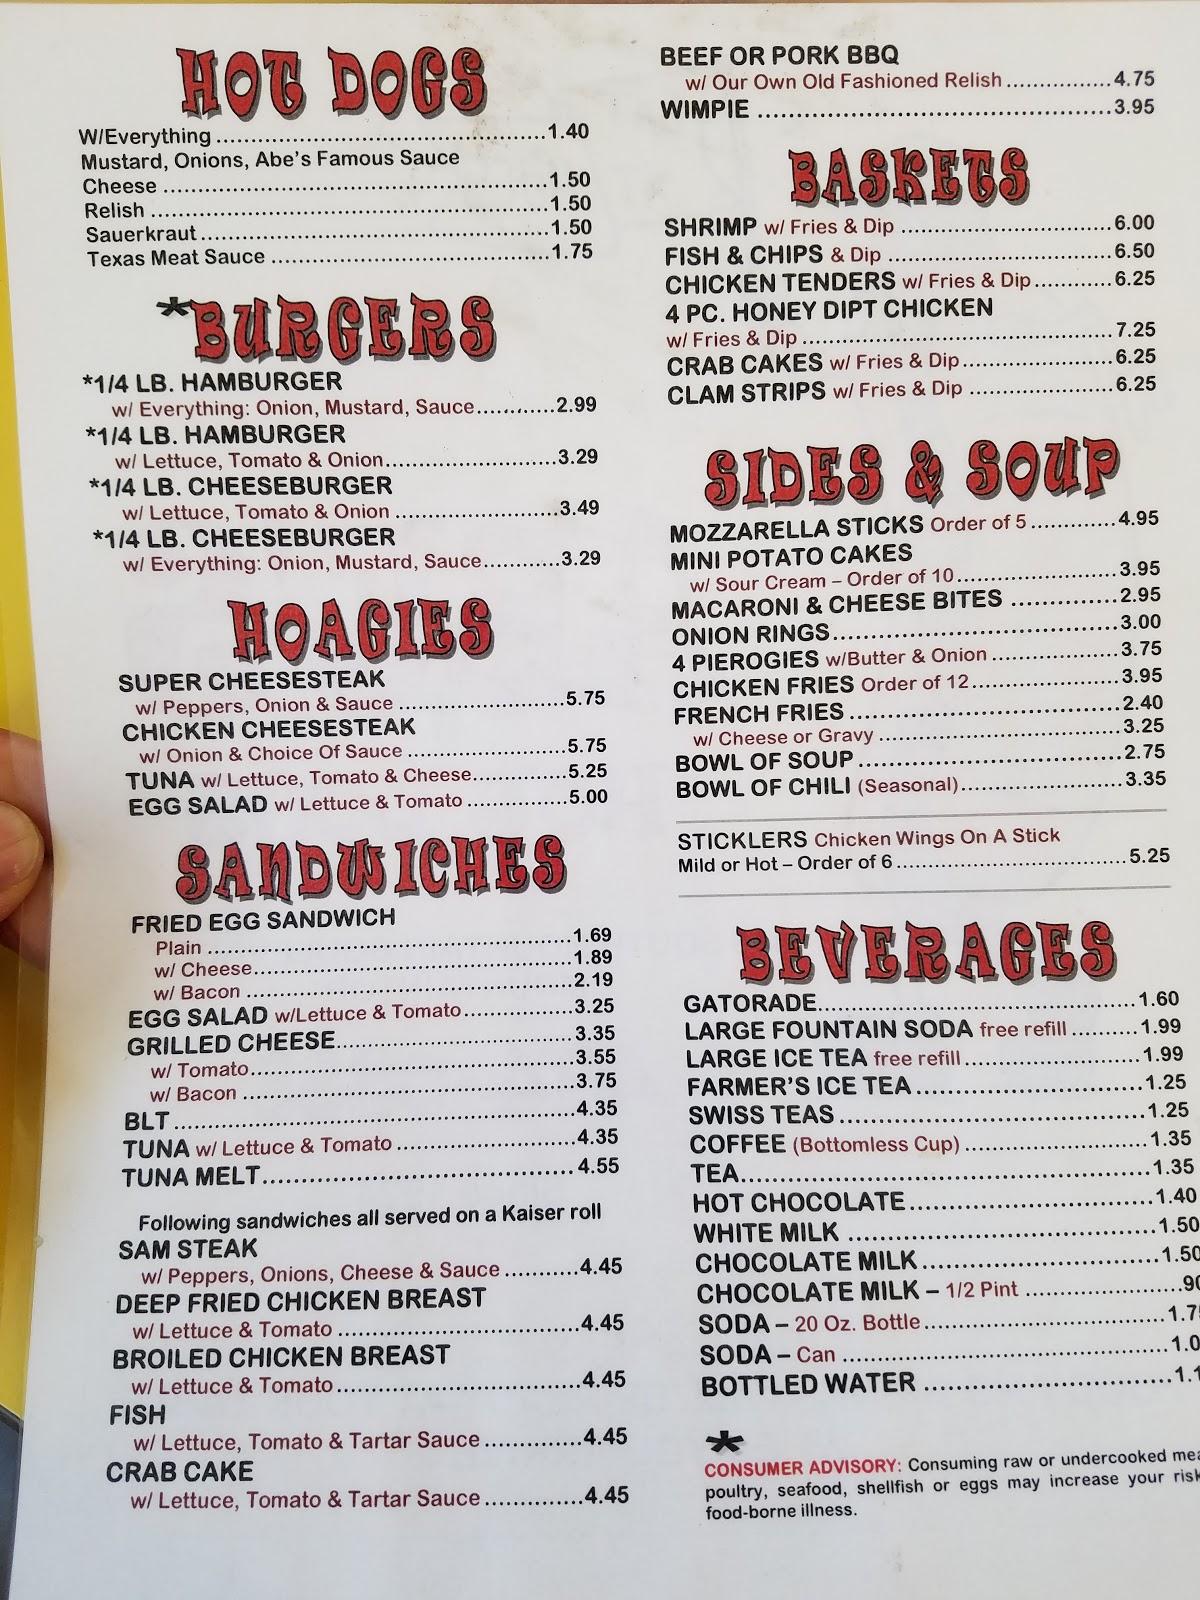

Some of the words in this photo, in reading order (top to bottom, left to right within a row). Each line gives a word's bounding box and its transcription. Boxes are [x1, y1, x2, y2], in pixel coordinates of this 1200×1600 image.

[660, 45, 724, 67] BEEF
[729, 45, 766, 67] OR
[771, 44, 840, 66] PORK
[847, 43, 900, 66] BBQ
[176, 48, 307, 120] HOT
[328, 46, 488, 120] DOGS
[684, 74, 707, 91] w/
[712, 73, 749, 91] Our
[753, 73, 797, 91] Own
[802, 72, 835, 90] Old
[840, 71, 939, 90] Fashioned
[944, 71, 1002, 89] Relish
[1113, 69, 1155, 87] 4.75
[660, 98, 750, 120] WIMPIE
[1114, 97, 1155, 115] 3.95
[78, 127, 212, 149] W/Everything
[547, 122, 590, 140] 1.40
[81, 152, 169, 173] Mustard,
[174, 151, 250, 171] Onions,
[317, 150, 394, 167] Famous
[399, 148, 460, 165] Sauce
[82, 177, 157, 195] Cheese
[549, 170, 591, 188] 1.50
[788, 147, 1030, 208] BASKETS
[84, 201, 145, 220] Relish
[550, 194, 592, 212] 1.50
[86, 224, 198, 244] Sauerkraut
[551, 218, 593, 236] 1.50
[664, 216, 758, 238] SHRIMP
[763, 218, 785, 236] w/
[790, 218, 838, 235] Fries
[843, 217, 858, 235] &
[863, 217, 895, 238] Dip
[1114, 214, 1155, 231] 6.00
[86, 250, 146, 268] Texas
[150, 248, 200, 267] Meat
[204, 248, 266, 265] Sauce
[551, 242, 594, 260] 1.75
[111, 401, 134, 418] w/
[139, 400, 250, 421] Everything:
[256, 399, 319, 419] Onion,
[324, 398, 410, 418] Mustard,
[415, 398, 475, 416] Sauce
[556, 395, 597, 414] 2.99
[114, 453, 137, 470] w/
[142, 452, 223, 472] Lettuce,
[227, 451, 303, 469] Tomato
[307, 451, 323, 468] &
[327, 451, 384, 468] Onion
[558, 447, 599, 466] 3.29
[704, 444, 884, 511] SIDES
[905, 440, 944, 509] &
[966, 436, 1121, 502] SOUP
[670, 550, 721, 571] MINI
[727, 546, 824, 569] POTATO
[830, 542, 913, 565] CAKES
[227, 597, 495, 666] HOAGIES
[671, 625, 749, 647] ONION
[756, 622, 830, 644] RINGS
[1120, 613, 1162, 631] 3.00
[118, 672, 203, 693] SUPER
[208, 669, 386, 691] CHEESESTEAK
[672, 677, 780, 700] CHICKEN
[787, 674, 855, 696] FRIES
[860, 676, 918, 693] Order
[922, 674, 942, 691] of
[946, 673, 969, 690] 12
[1121, 667, 1163, 684] 3.95
[135, 699, 157, 716] w/
[163, 699, 250, 719] Peppers,
[255, 697, 310, 713] Onion
[316, 696, 331, 712] &
[335, 696, 394, 712] Sauce
[566, 689, 606, 707] 5.75
[692, 731, 714, 747] w/
[718, 730, 788, 747] Cheese
[792, 731, 813, 744] or
[818, 727, 874, 746] Gravy
[1123, 717, 1165, 734] 3.25
[677, 830, 808, 851] STICKLERS
[814, 831, 891, 848] Chicken
[895, 830, 955, 849] Wings
[960, 828, 987, 845] On
[992, 828, 1008, 844] A
[1012, 827, 1061, 844] Stick
[176, 834, 567, 904] SANDWICHES
[131, 913, 203, 935] FRIED
[209, 911, 261, 932] EGG
[266, 907, 396, 930] SANDWICH
[156, 939, 202, 956] Plain
[573, 926, 612, 944] 1.69
[736, 920, 1117, 985] BEVERAGES
[683, 992, 818, 1014] GATORADE
[1138, 990, 1180, 1007] 1.60
[127, 1034, 232, 1057] GRILLED
[237, 1030, 336, 1053] CHEESE
[575, 1024, 616, 1042] 3.35
[124, 1110, 171, 1132] BLT
[576, 1099, 618, 1117] 4.35
[688, 1104, 765, 1126] SWISS
[769, 1103, 835, 1125] TEAS
[1147, 1101, 1190, 1119] 1.25
[689, 1133, 787, 1155] COFFEE
[792, 1135, 909, 1158] (Bottomless
[913, 1135, 960, 1156] Cup)
[1150, 1129, 1192, 1147] 1.35
[121, 1166, 190, 1188] TUNA
[195, 1164, 261, 1187] MELT
[577, 1156, 620, 1175] 4.55
[689, 1162, 740, 1184] TEA
[1152, 1157, 1195, 1176] 1.35
[692, 1192, 745, 1214] HOT
[750, 1190, 906, 1214] CHOCOLATE
[1155, 1186, 1198, 1205] 1.40
[138, 1213, 231, 1235] Following
[236, 1210, 352, 1230] sandwiches
[356, 1208, 380, 1227] all
[384, 1206, 451, 1226] served
[455, 1209, 480, 1224] on
[484, 1208, 497, 1223] a
[502, 1203, 566, 1222] Kaiser
[570, 1202, 602, 1221] roll
[118, 1239, 171, 1261] SAM
[177, 1237, 258, 1260] STEAK
[112, 1347, 223, 1370] BROILED
[228, 1345, 343, 1369] CHICKEN
[350, 1343, 452, 1367] BREAST
[131, 1377, 154, 1396] w/
[159, 1377, 234, 1395] Lettuce
[238, 1376, 254, 1395] &
[258, 1375, 334, 1395] Tomato
[581, 1369, 627, 1389] 4.45
[109, 1403, 166, 1426] FISH
[704, 1460, 804, 1478] CONSUMER
[808, 1457, 902, 1476] ADVISORY:
[907, 1455, 998, 1473] Consuming
[1003, 1456, 1033, 1469] raw
[1038, 1455, 1056, 1468] or
[1060, 1447, 1167, 1467] undercooked
[705, 1483, 768, 1503] poultry,
[777, 1480, 848, 1499] seafood,
[856, 1478, 924, 1495] shellfish
[932, 1480, 951, 1493] or
[959, 1479, 999, 1495] eggs
[1007, 1477, 1041, 1493] may
[1049, 1473, 1120, 1488] increase
[1127, 1472, 1165, 1489] your
[705, 1504, 797, 1521] food-borne
[800, 1501, 858, 1518] illness.
